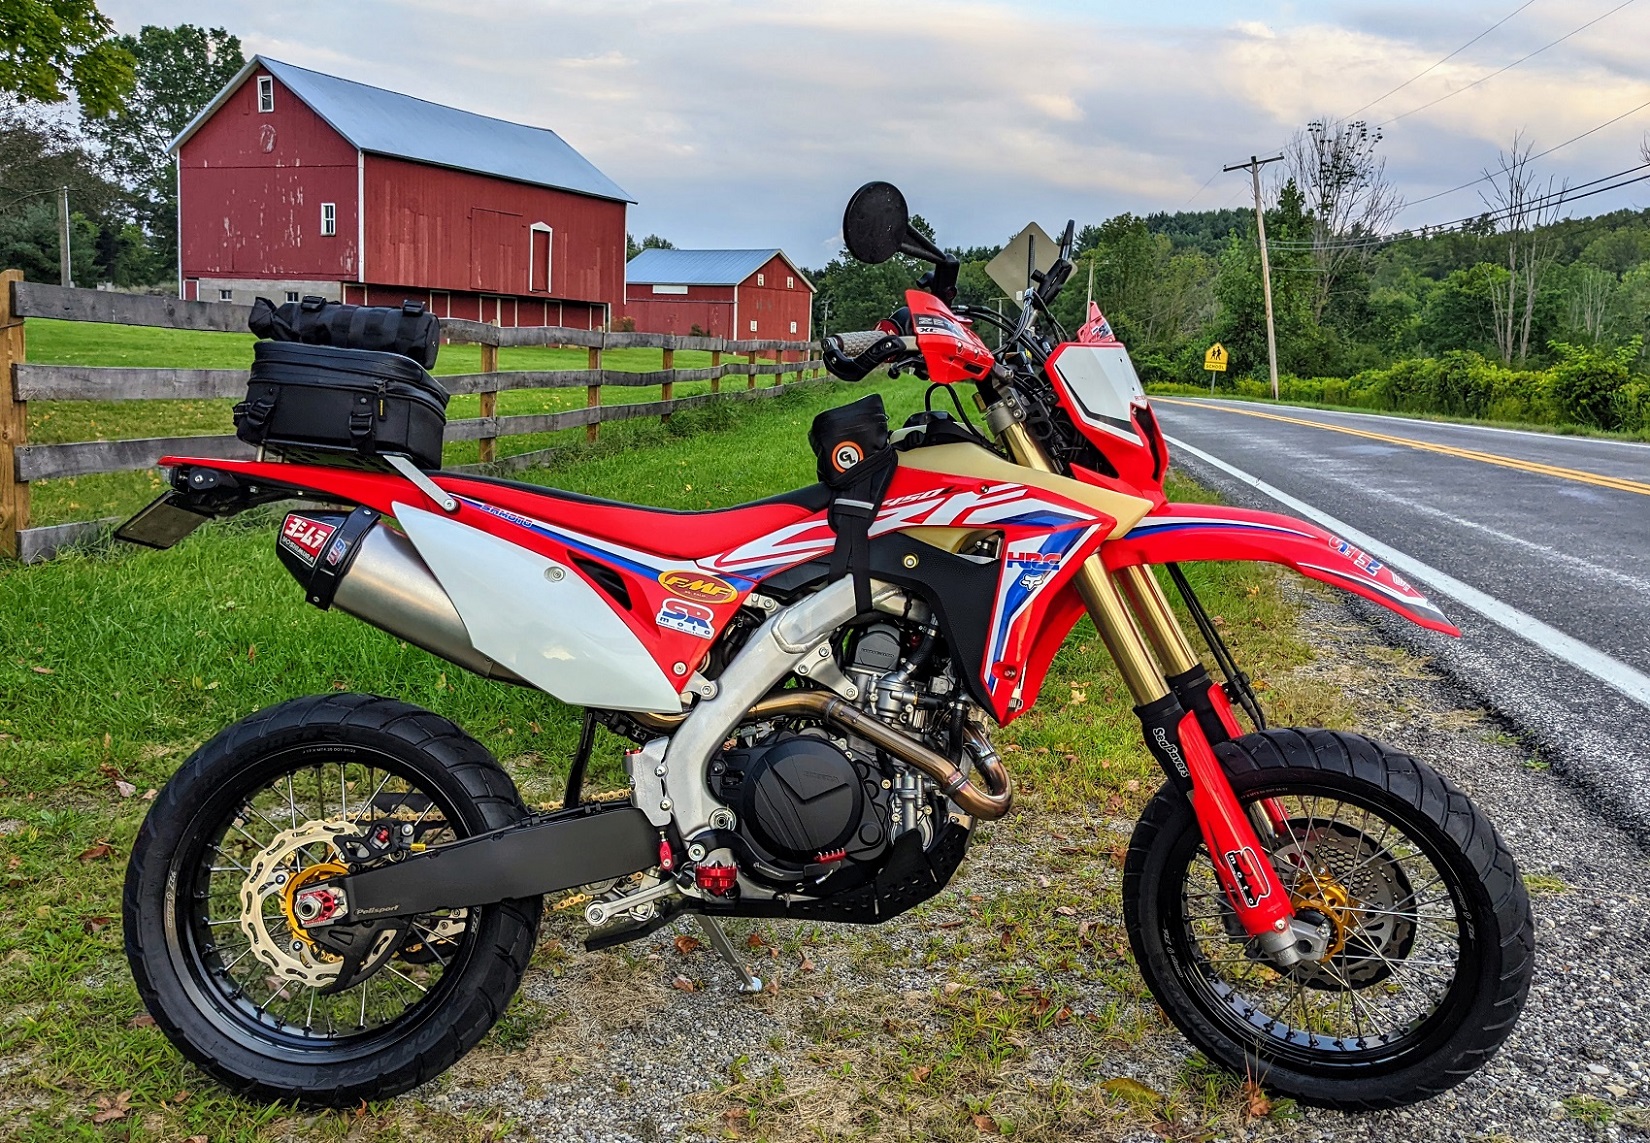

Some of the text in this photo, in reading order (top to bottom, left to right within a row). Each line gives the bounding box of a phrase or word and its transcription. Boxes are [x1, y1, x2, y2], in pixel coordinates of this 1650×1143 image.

[284, 518, 328, 549] ヨシムラ
[282, 536, 315, 563] YOSHIMURA
[1007, 552, 1061, 571] HRC
[664, 576, 734, 596] FMF
[659, 616, 711, 635] moto
[661, 600, 711, 630] SR
